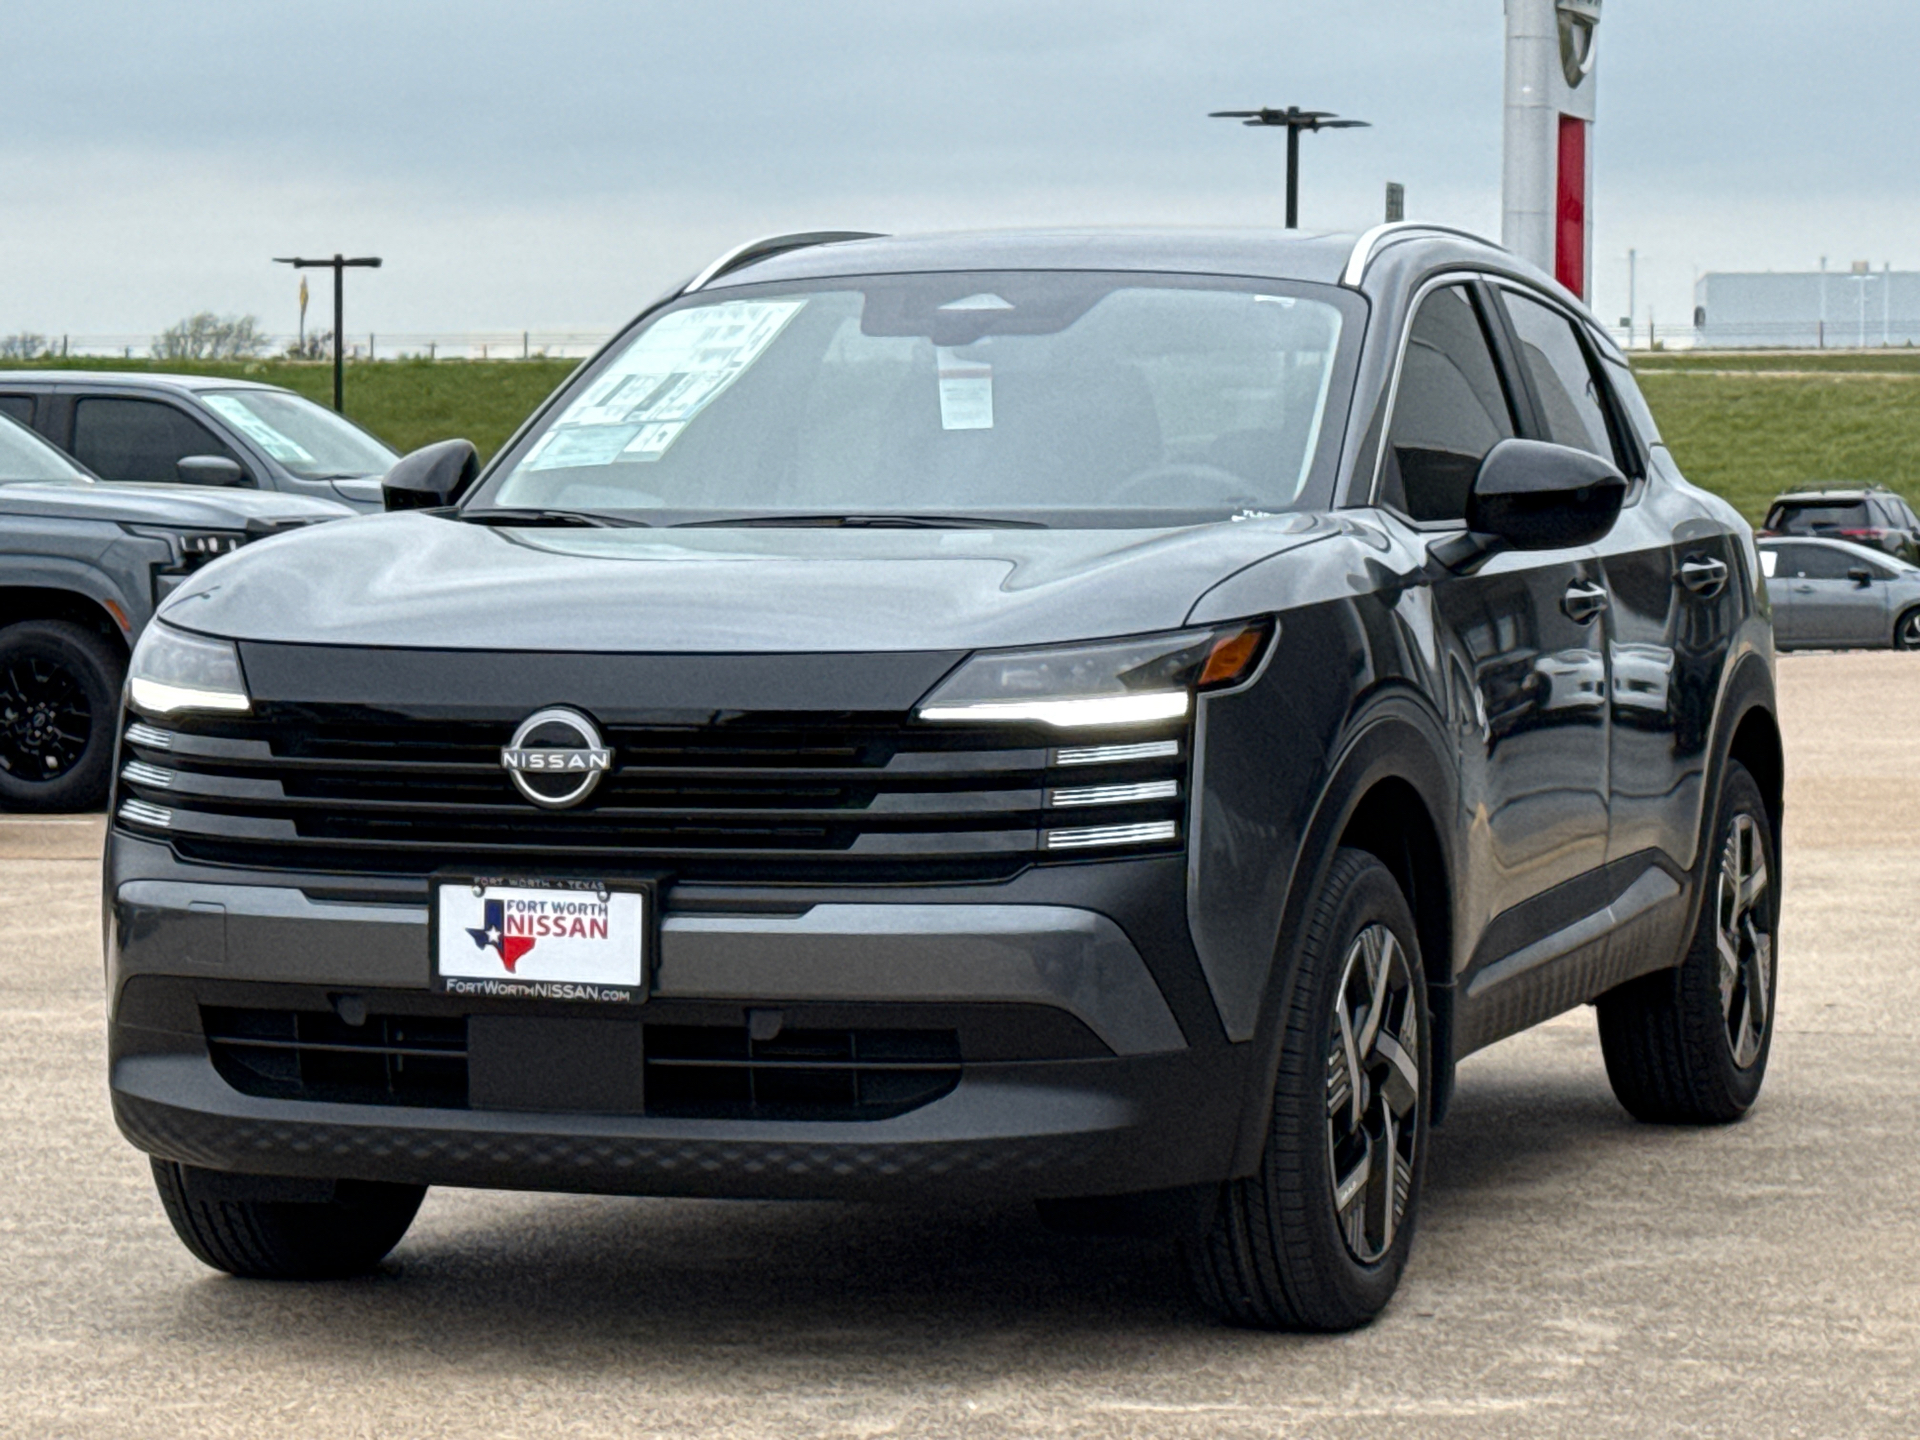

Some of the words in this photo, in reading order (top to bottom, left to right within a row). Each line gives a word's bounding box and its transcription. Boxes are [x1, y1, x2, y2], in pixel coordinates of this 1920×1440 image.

[504, 752, 607, 769] NISSAN
[474, 877, 503, 886] FORT
[508, 878, 550, 888] WORTH
[568, 880, 605, 891] TEXAS
[506, 900, 547, 914] FORT
[551, 901, 608, 917] WORTH
[506, 914, 608, 940] NISSAN
